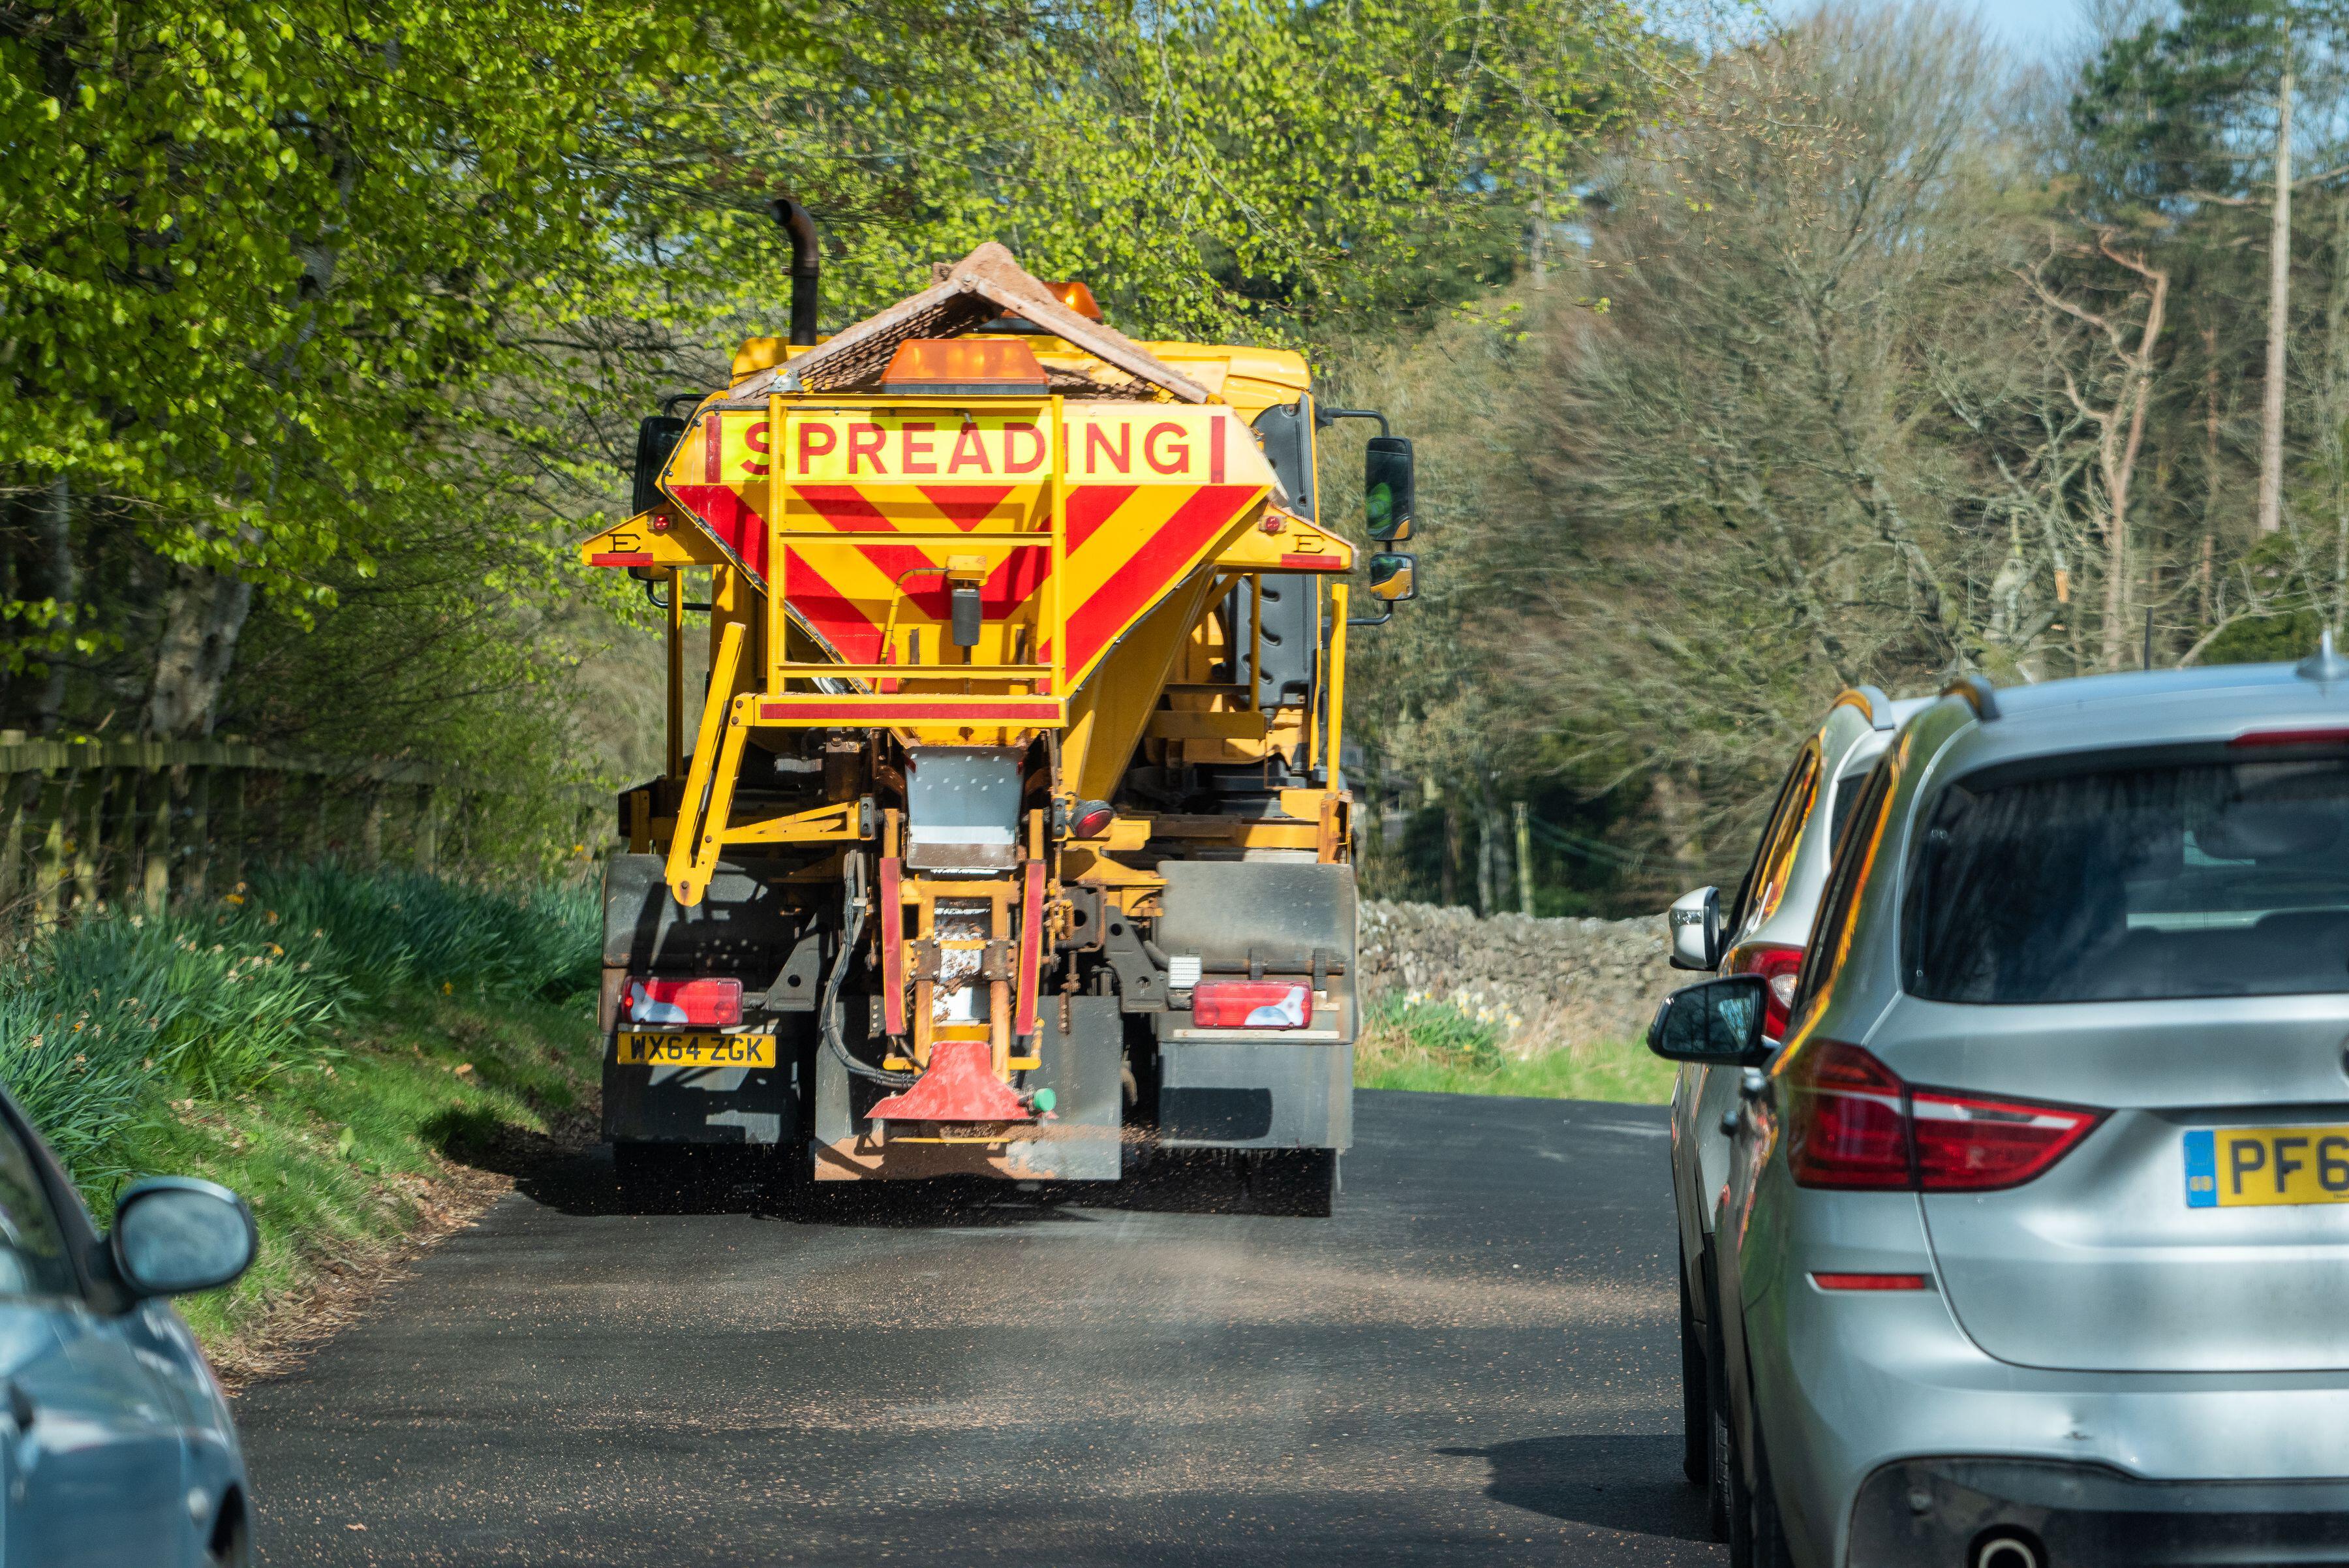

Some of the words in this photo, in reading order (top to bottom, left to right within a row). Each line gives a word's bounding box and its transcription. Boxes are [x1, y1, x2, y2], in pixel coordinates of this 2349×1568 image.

[740, 422, 1190, 475] SPREADING
[630, 1036, 701, 1060] WX64
[710, 1036, 763, 1062] ZGK
[2229, 1135, 2349, 1194] PF6
